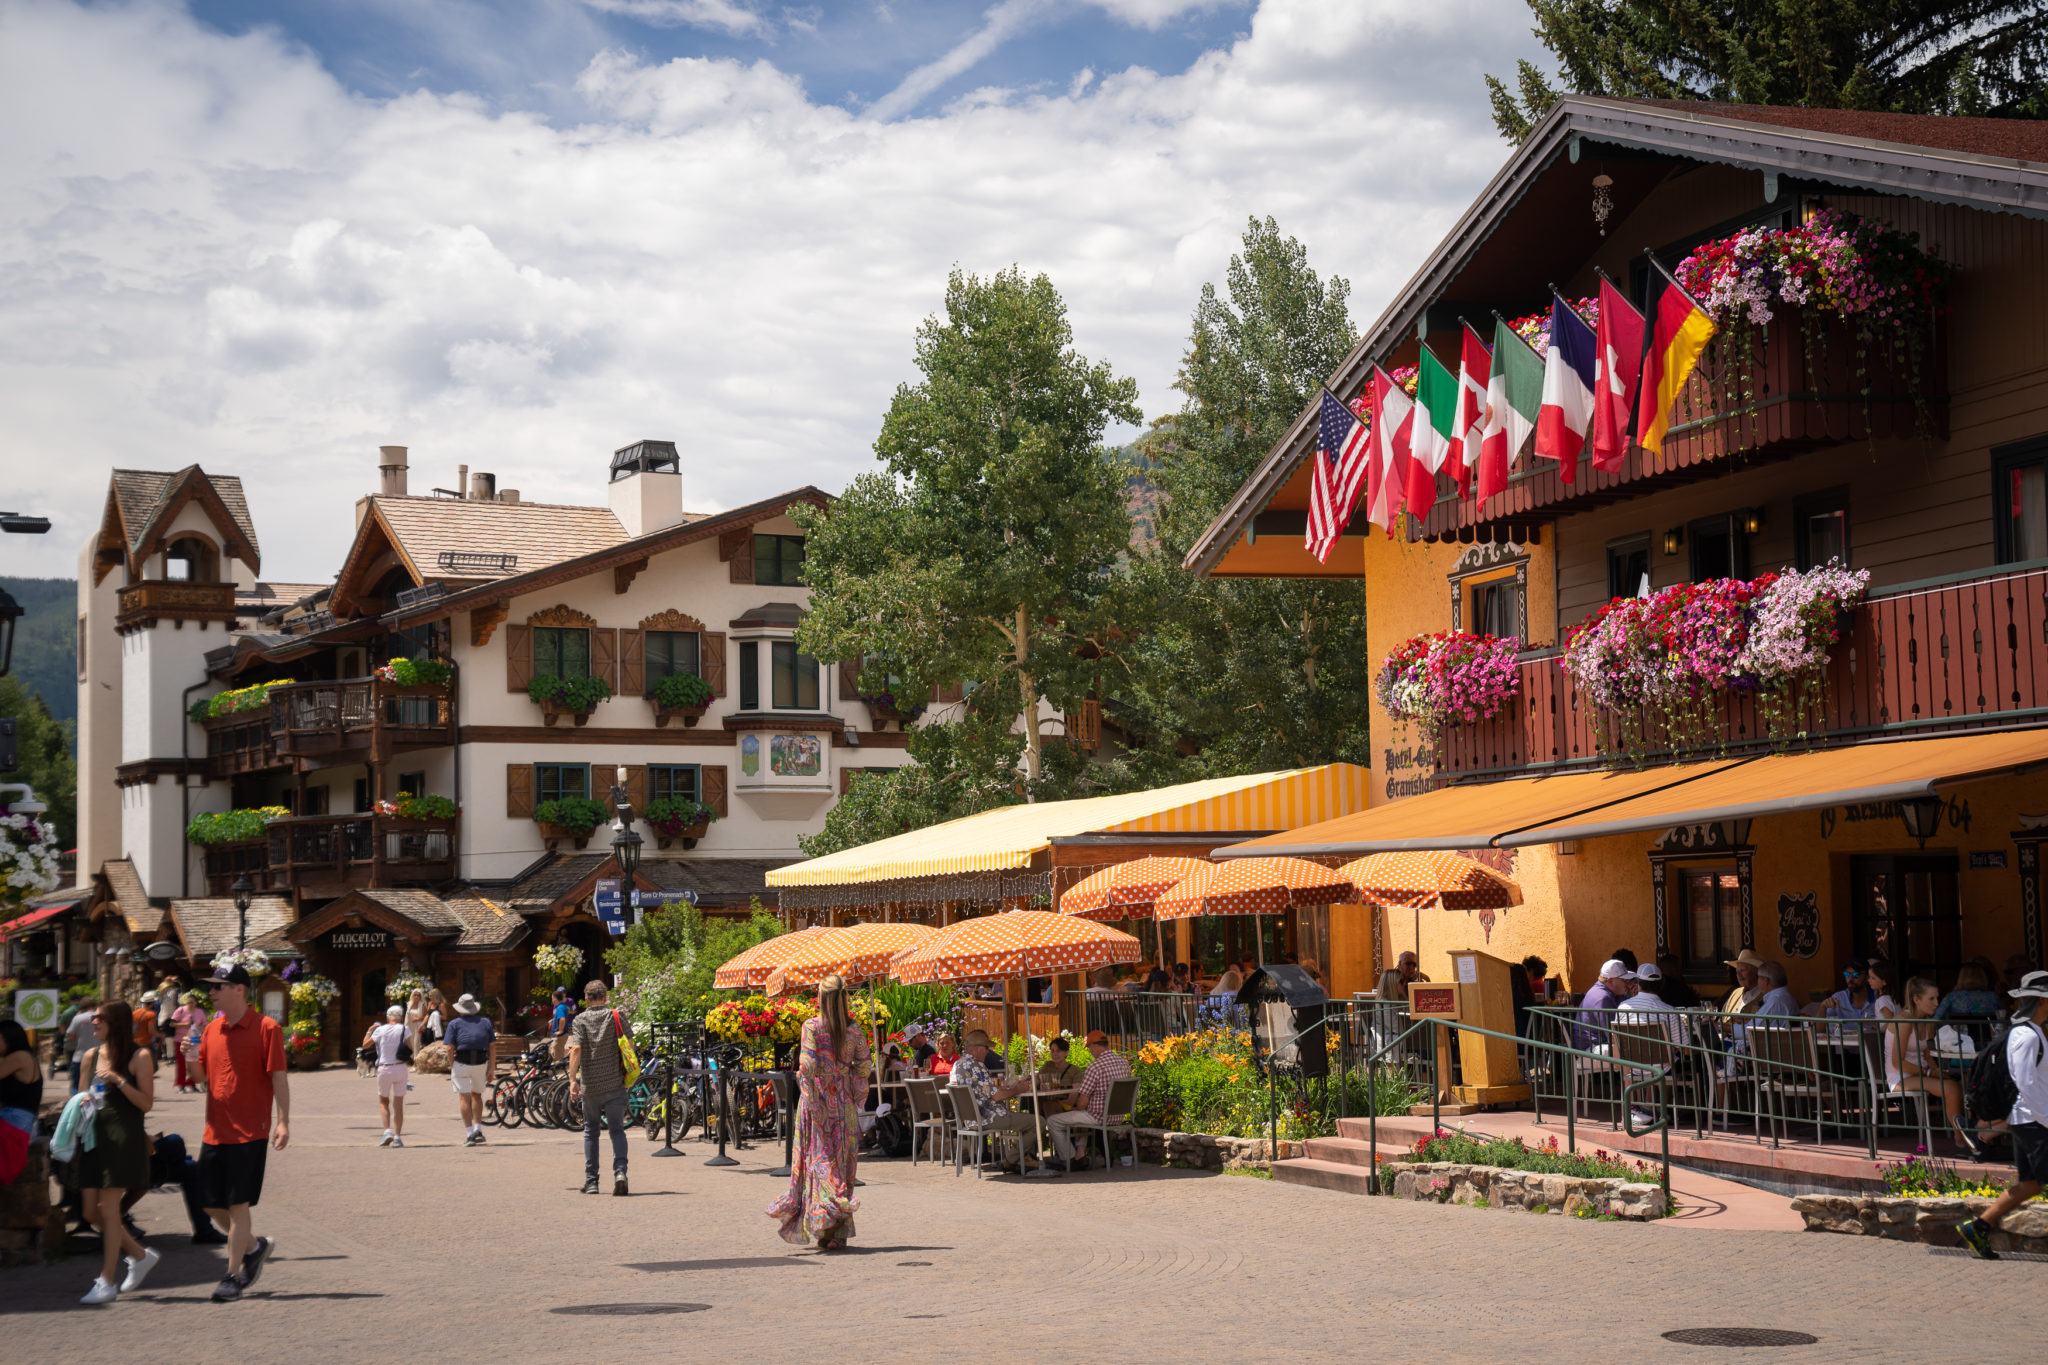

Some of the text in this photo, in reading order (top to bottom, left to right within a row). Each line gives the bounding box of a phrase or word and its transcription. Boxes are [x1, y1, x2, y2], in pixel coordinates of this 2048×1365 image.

[1948, 793, 1972, 834] 64
[332, 933, 387, 943] LANCELOT
[1795, 929, 1814, 948] Bar
